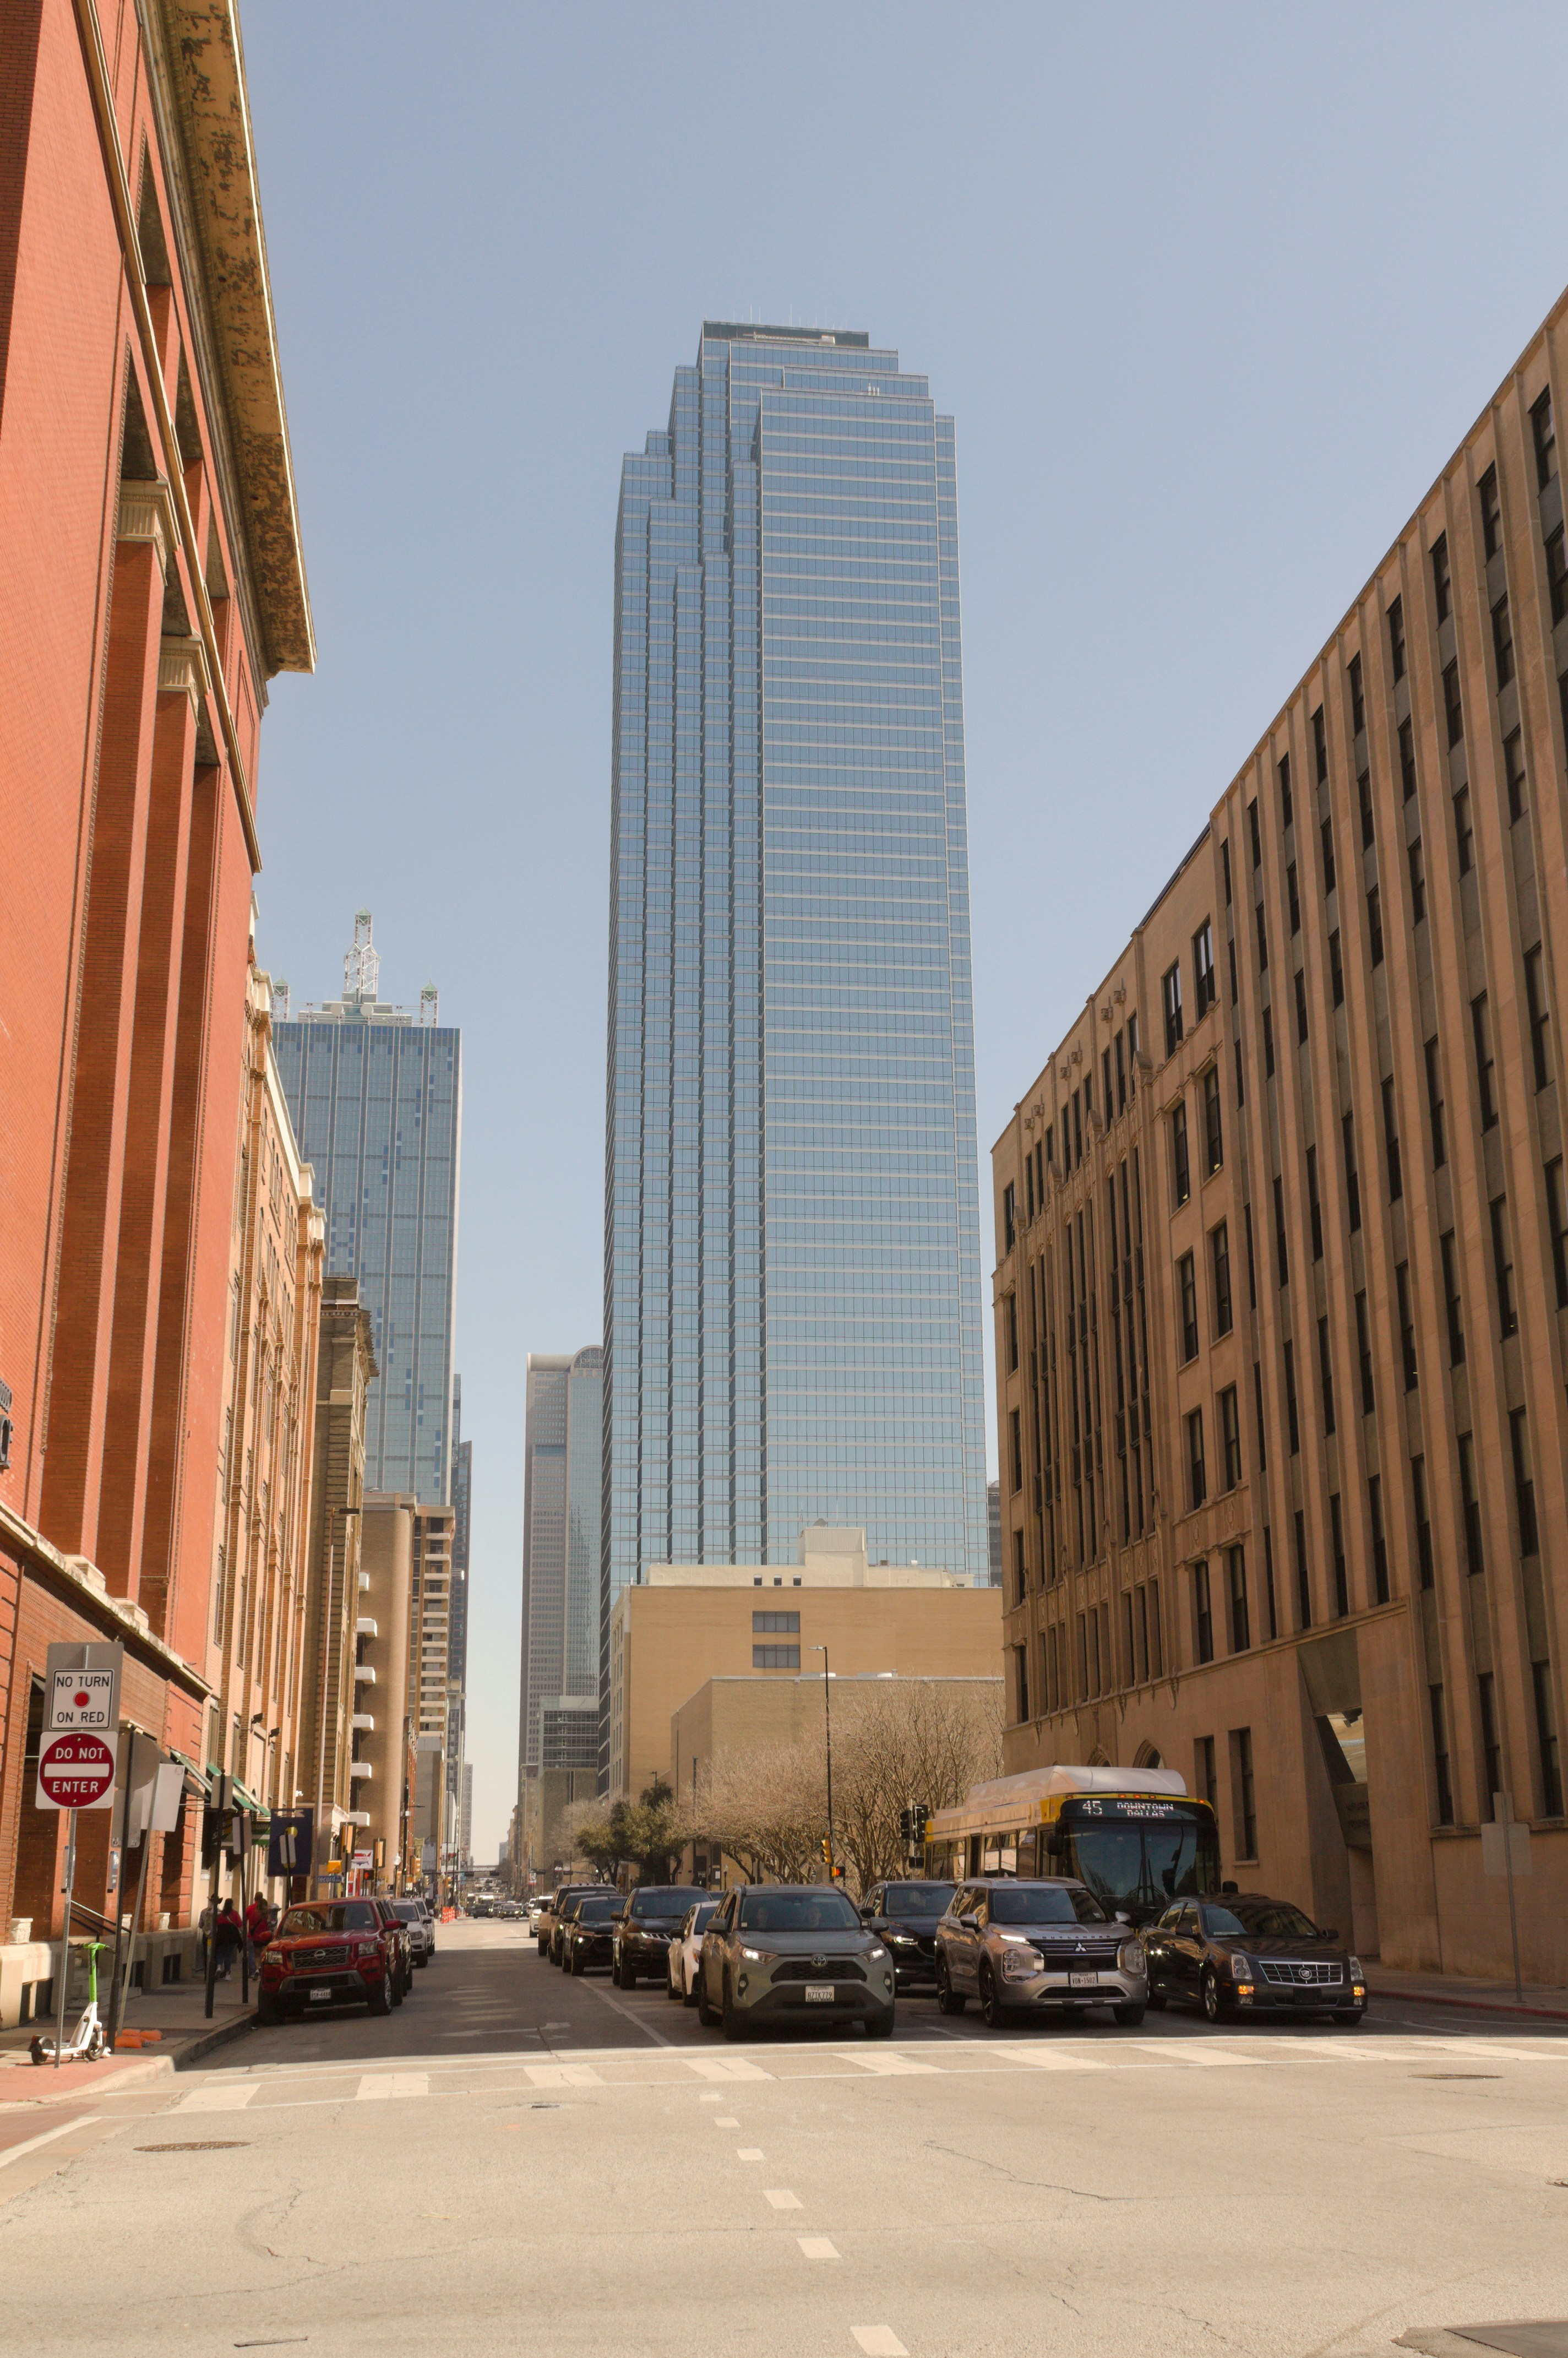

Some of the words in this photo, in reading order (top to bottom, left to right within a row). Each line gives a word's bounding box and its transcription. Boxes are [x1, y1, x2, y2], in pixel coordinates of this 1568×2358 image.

[57, 1676, 73, 1687] NO
[78, 1676, 110, 1687] TURN
[57, 1712, 73, 1723] ON
[81, 1712, 105, 1723] RED
[56, 1747, 73, 1759] DO
[79, 1747, 105, 1759] NOT
[52, 1781, 99, 1792] ENTER
[1082, 1800, 1102, 1815] 45
[1117, 1802, 1174, 1811] DOWNTOWN
